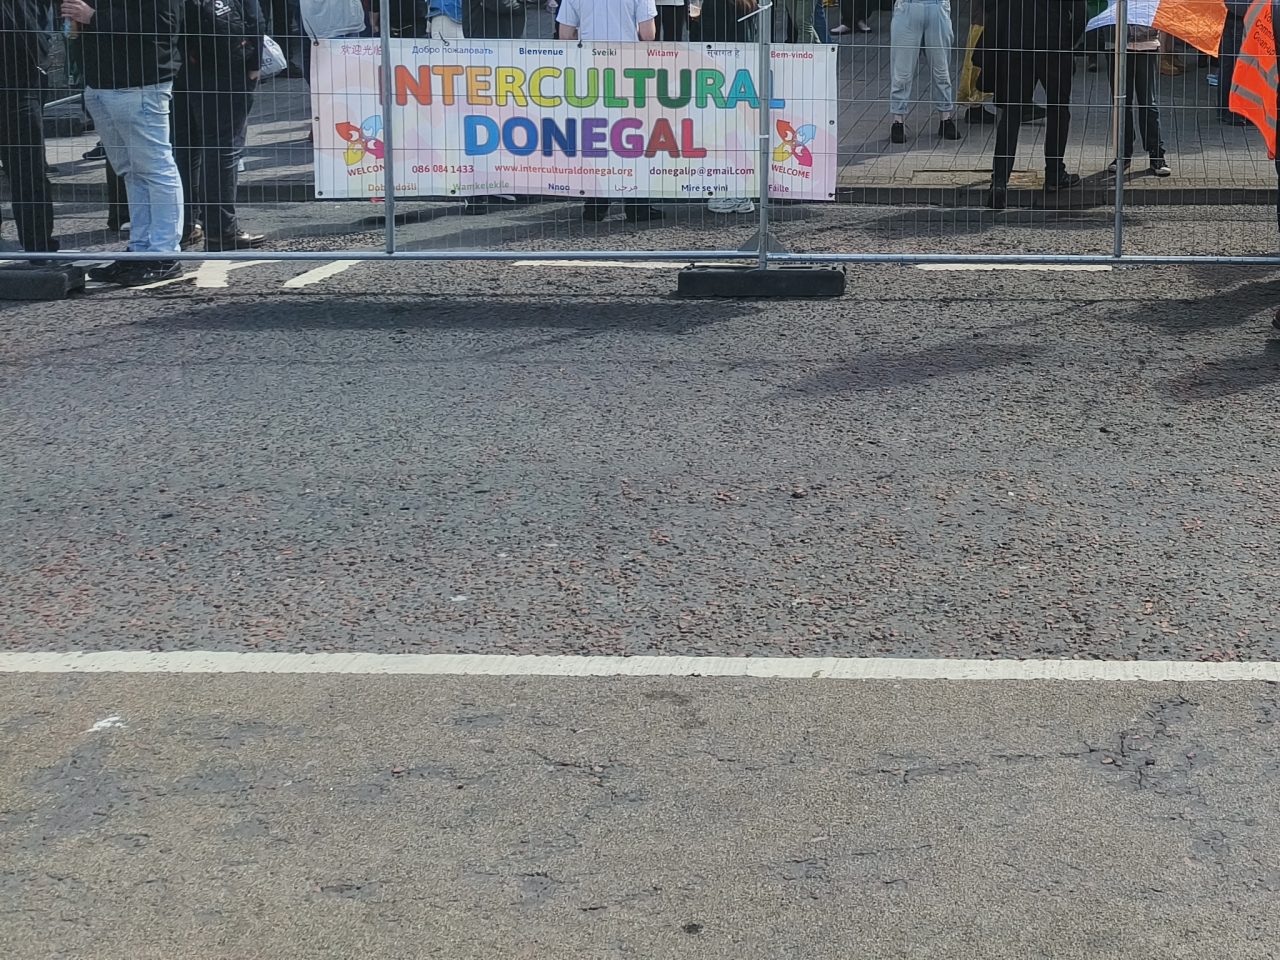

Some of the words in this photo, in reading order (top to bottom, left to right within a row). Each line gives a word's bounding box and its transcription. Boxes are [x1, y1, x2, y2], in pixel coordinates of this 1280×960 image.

[412, 45, 440, 55] Добро
[443, 46, 494, 55] пожаловать
[519, 47, 564, 56] Bienvenue
[592, 48, 617, 57] Sveiki
[646, 49, 679, 59] Witamy
[770, 50, 814, 59] Bem-vindo
[378, 64, 786, 109] NTERCULTURAL
[463, 114, 707, 158] DONEGAL
[412, 165, 430, 174] 086
[432, 165, 448, 174] 084
[450, 164, 474, 174] 1433
[494, 164, 633, 177] www.interculturaldonegal.org
[771, 164, 810, 179] WELCOME
[714, 184, 729, 192] vini
